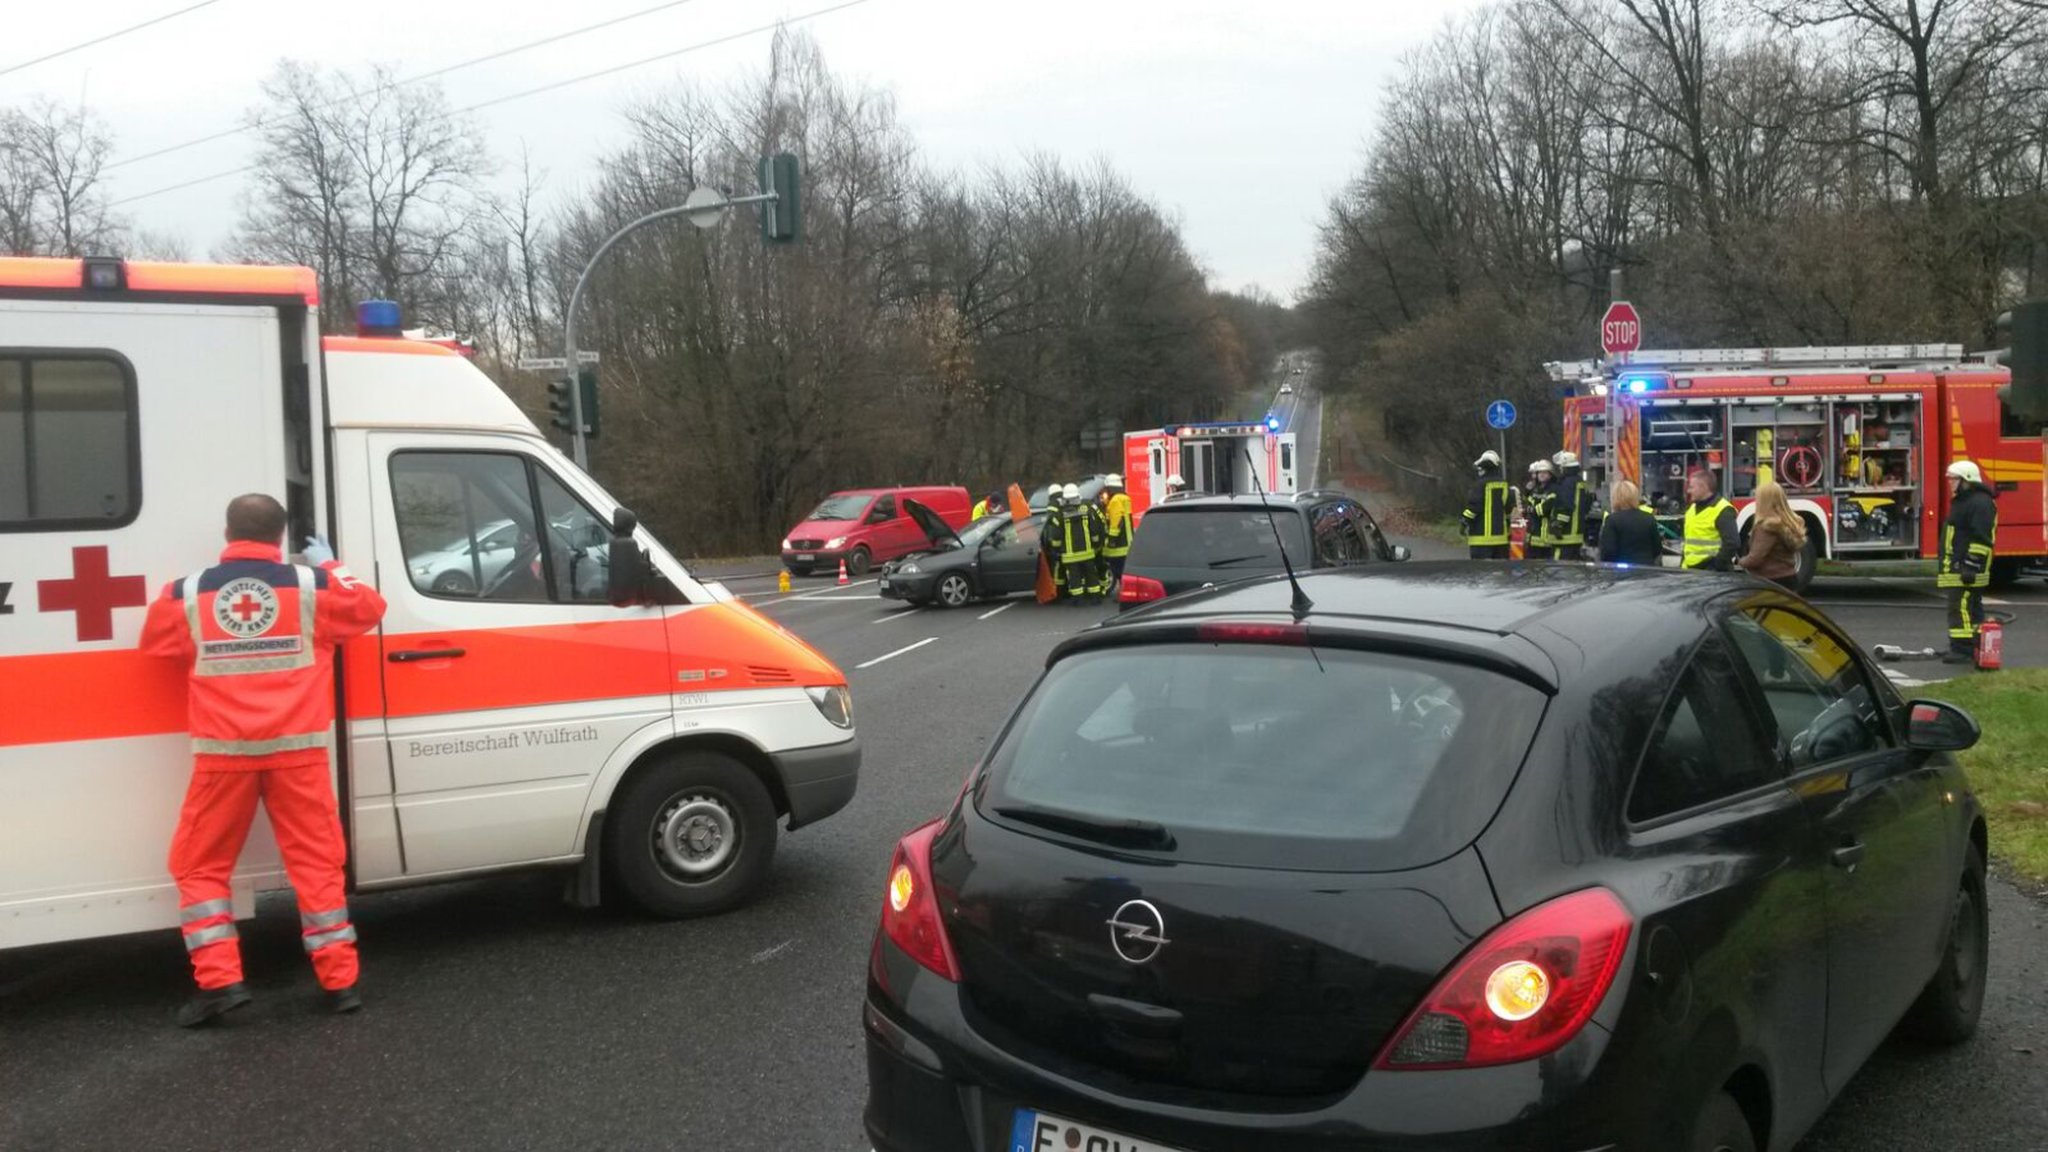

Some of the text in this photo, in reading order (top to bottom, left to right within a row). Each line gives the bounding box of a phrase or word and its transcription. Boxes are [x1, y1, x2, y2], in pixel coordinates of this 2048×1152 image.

[1605, 321, 1637, 344] STOP
[220, 582, 272, 602] DEUTSCHES
[219, 606, 274, 632] ROTES KREUZ
[203, 638, 299, 655] RETTUNGSDIENST
[409, 732, 520, 759] Bereitschaft
